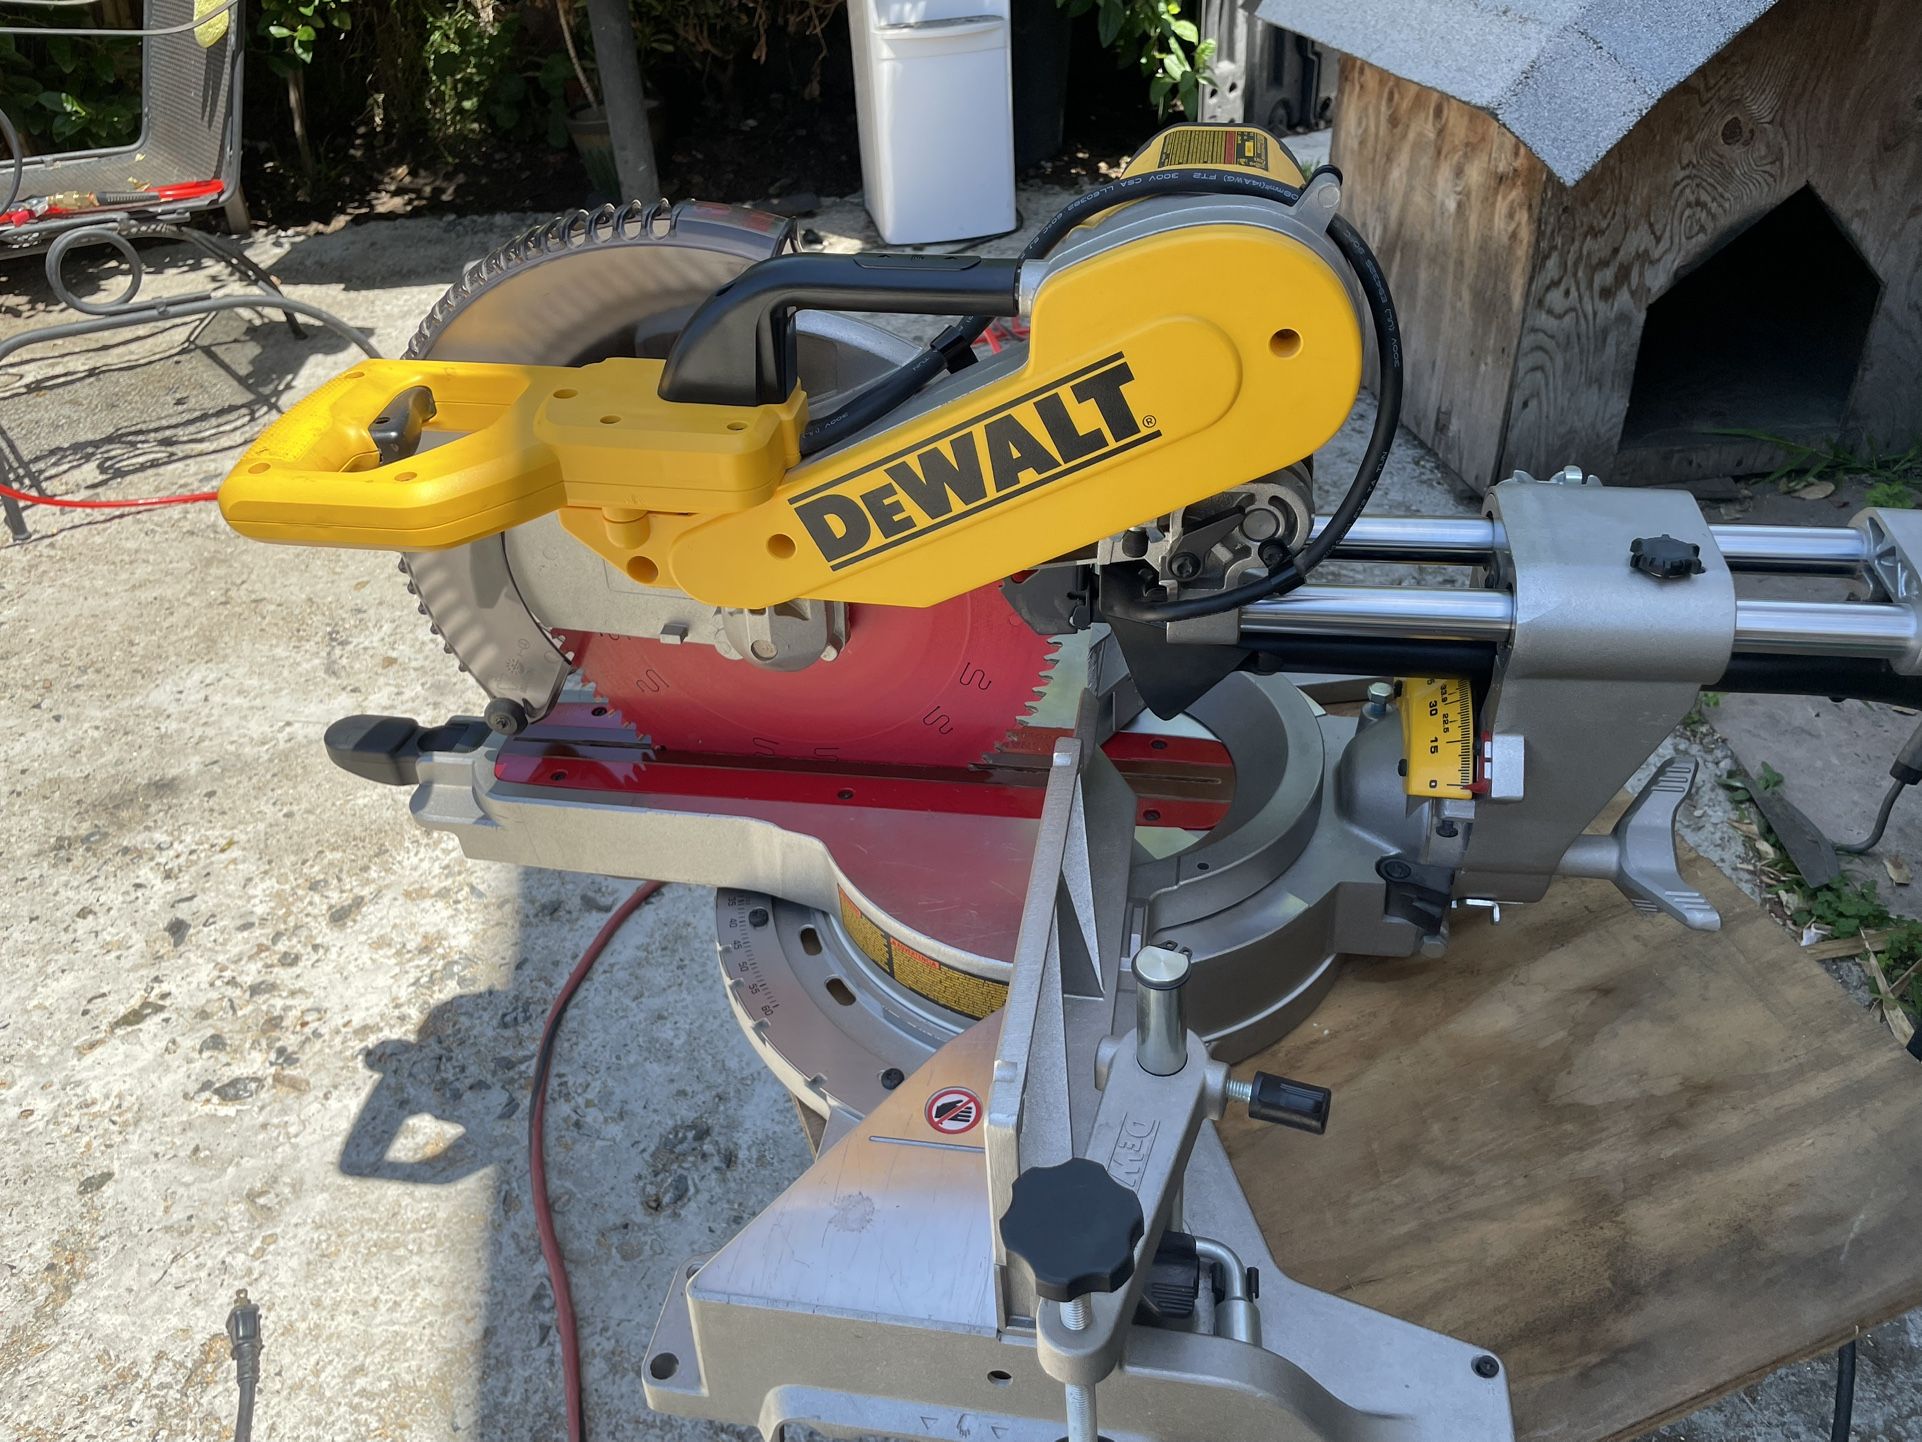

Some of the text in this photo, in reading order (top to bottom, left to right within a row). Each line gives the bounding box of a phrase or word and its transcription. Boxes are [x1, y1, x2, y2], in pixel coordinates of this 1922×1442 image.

[1120, 178, 1142, 187] CSA
[1149, 172, 1179, 181] 300V
[1193, 172, 1217, 180] FT2
[1440, 685, 1448, 703] 33.9
[1428, 700, 1438, 717] 30
[1442, 713, 1450, 734] 22.5
[1429, 736, 1439, 755] 15
[1429, 779, 1438, 789] 0
[728, 896, 774, 1017] 35 40 45 50 55 60
[1109, 1117, 1156, 1188] DEW
